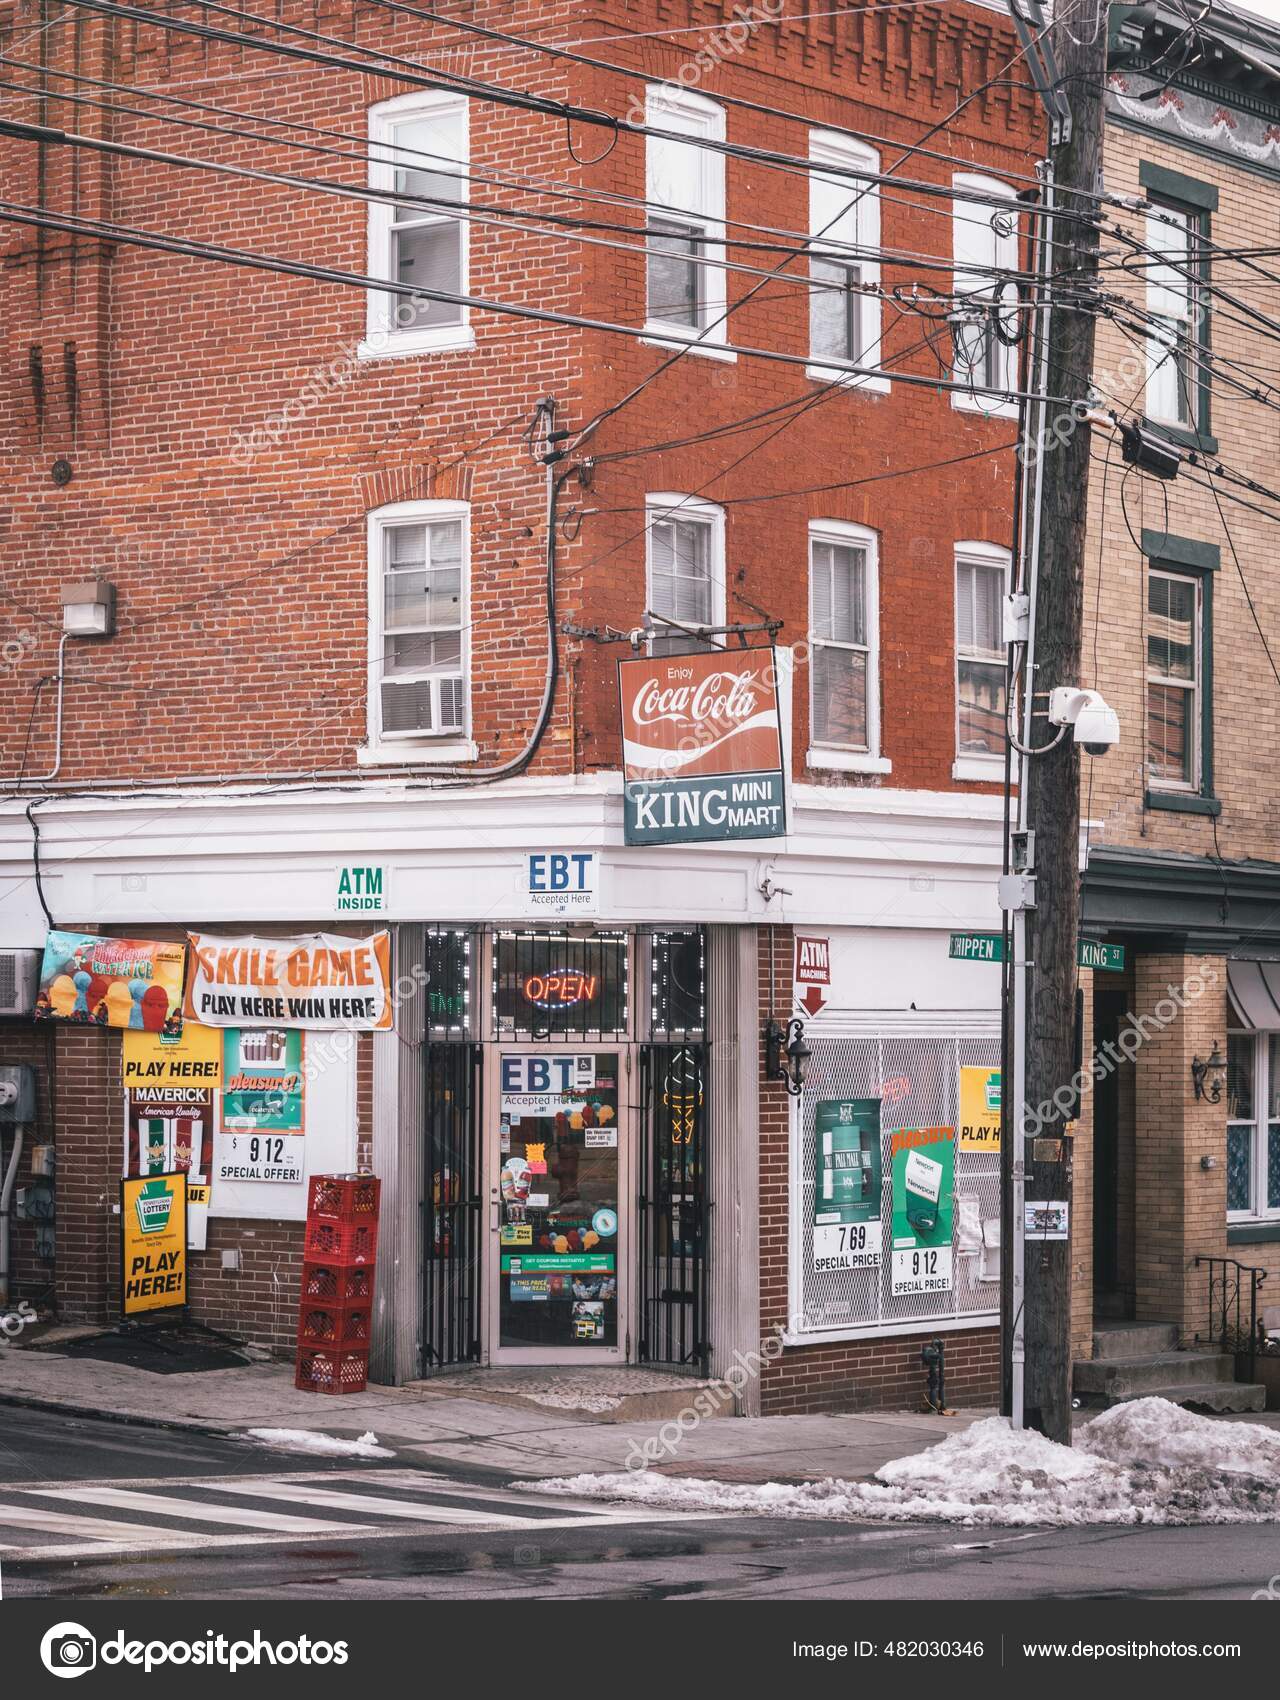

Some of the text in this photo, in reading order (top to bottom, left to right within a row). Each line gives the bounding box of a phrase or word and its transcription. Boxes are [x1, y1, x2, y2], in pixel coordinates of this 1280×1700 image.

[667, 667, 694, 681] Enjoy
[632, 669, 760, 726] Coca-Cola
[732, 781, 772, 802] MINI
[634, 789, 729, 830] KING
[728, 806, 781, 828] MART
[338, 867, 383, 895] ATM
[529, 854, 593, 890] EBT
[338, 898, 382, 909] INSIDE
[531, 893, 591, 905] Accepted Here
[800, 941, 828, 968] ATM
[1082, 945, 1120, 966] KING ST
[201, 946, 375, 987] SKILL GAME
[800, 968, 828, 981] MACHINE
[526, 976, 596, 1000] OPEN
[202, 993, 376, 1019] PLAY HERE WIN HERE
[126, 1061, 219, 1077] PLAY HERE!
[502, 1058, 574, 1092] EBT
[136, 1087, 206, 1102] MAVERICK
[227, 1072, 298, 1096] pleasure!
[505, 1096, 550, 1106] Accepted
[140, 1105, 201, 1119] American Quality
[961, 1126, 991, 1141] PLAY
[250, 1137, 284, 1163] 9.12
[221, 1166, 300, 1180] SPECIAL OFFER!
[907, 1177, 937, 1197] Newport
[143, 1203, 170, 1214] LOTTERY
[838, 1226, 866, 1252] 7.69
[131, 1250, 180, 1276] PLAY
[815, 1253, 881, 1271] SPECIAL PRICE!
[912, 1251, 937, 1275] 9.12
[126, 1271, 183, 1299] HERE!
[895, 1278, 949, 1293] SPECIAL PRICE!
